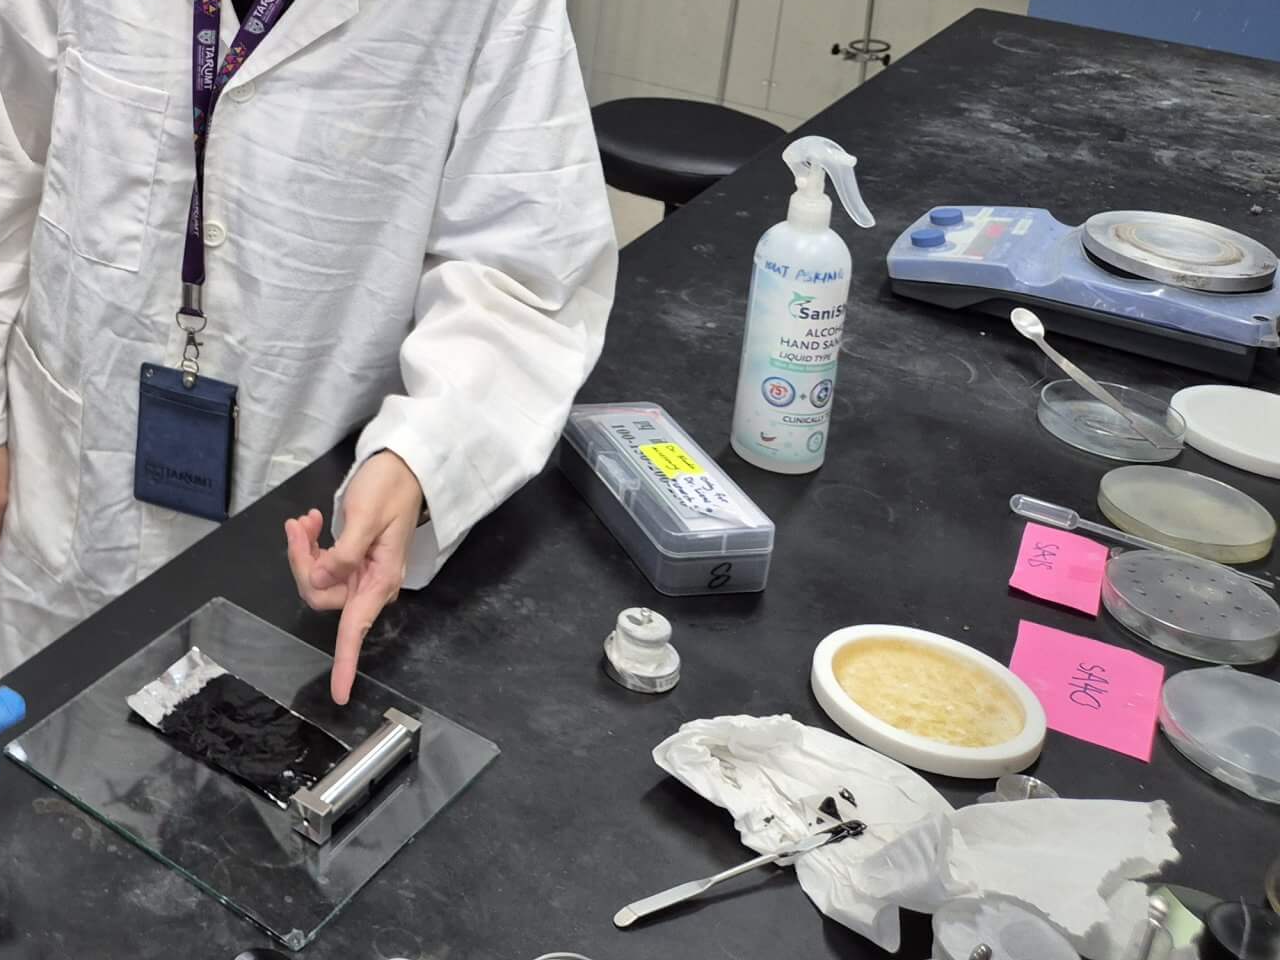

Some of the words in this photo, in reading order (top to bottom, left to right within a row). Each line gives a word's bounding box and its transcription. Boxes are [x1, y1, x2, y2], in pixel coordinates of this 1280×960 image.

[200, 46, 216, 90] TARUMT
[780, 336, 820, 351] HAND
[779, 351, 813, 363] LIQUID
[707, 561, 733, 590] 8
